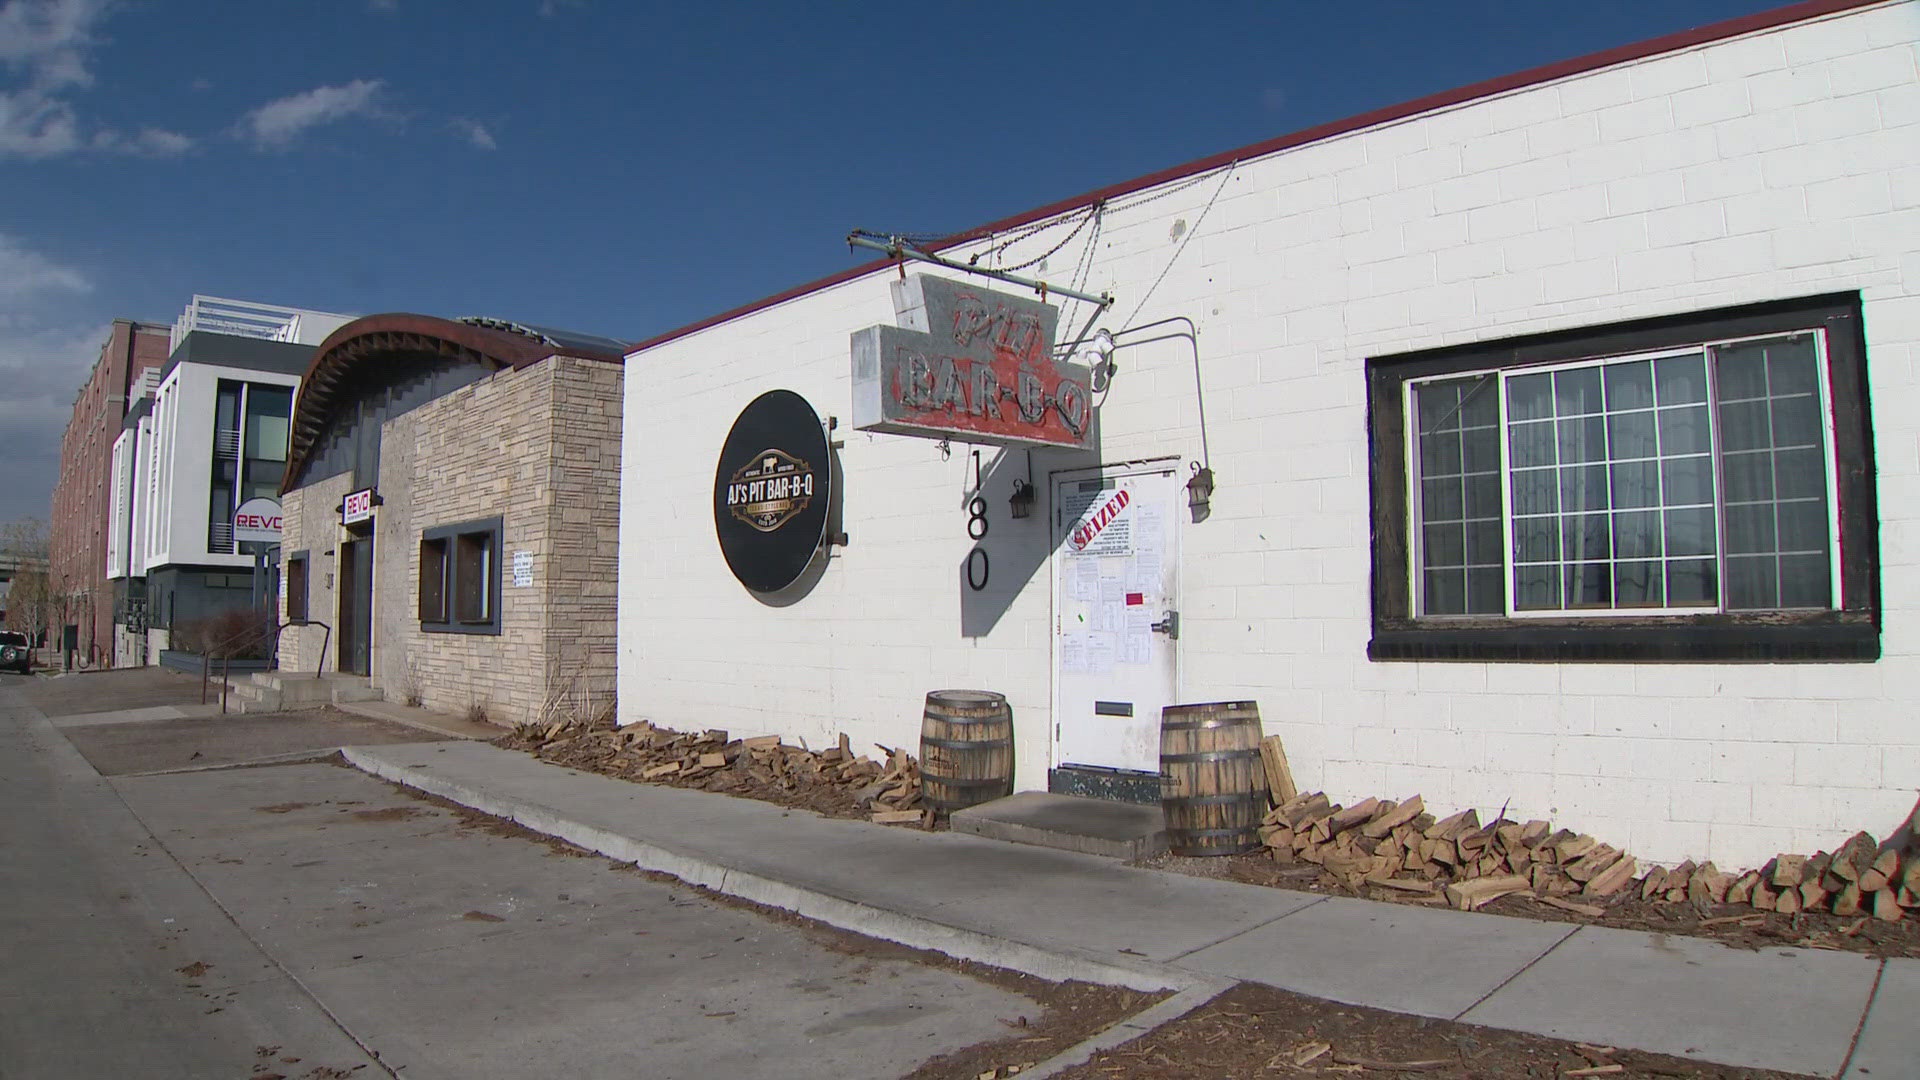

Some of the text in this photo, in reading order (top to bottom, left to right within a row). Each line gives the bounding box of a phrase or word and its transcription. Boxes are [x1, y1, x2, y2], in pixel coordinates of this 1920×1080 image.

[952, 295, 1040, 359] PIT
[898, 350, 1090, 440] BAR-B-Q
[348, 493, 369, 514] REVO
[749, 480, 766, 502] PIT
[767, 473, 813, 500] BAR-B-Q
[967, 449, 989, 591] 180
[1074, 490, 1130, 551] SEIZED
